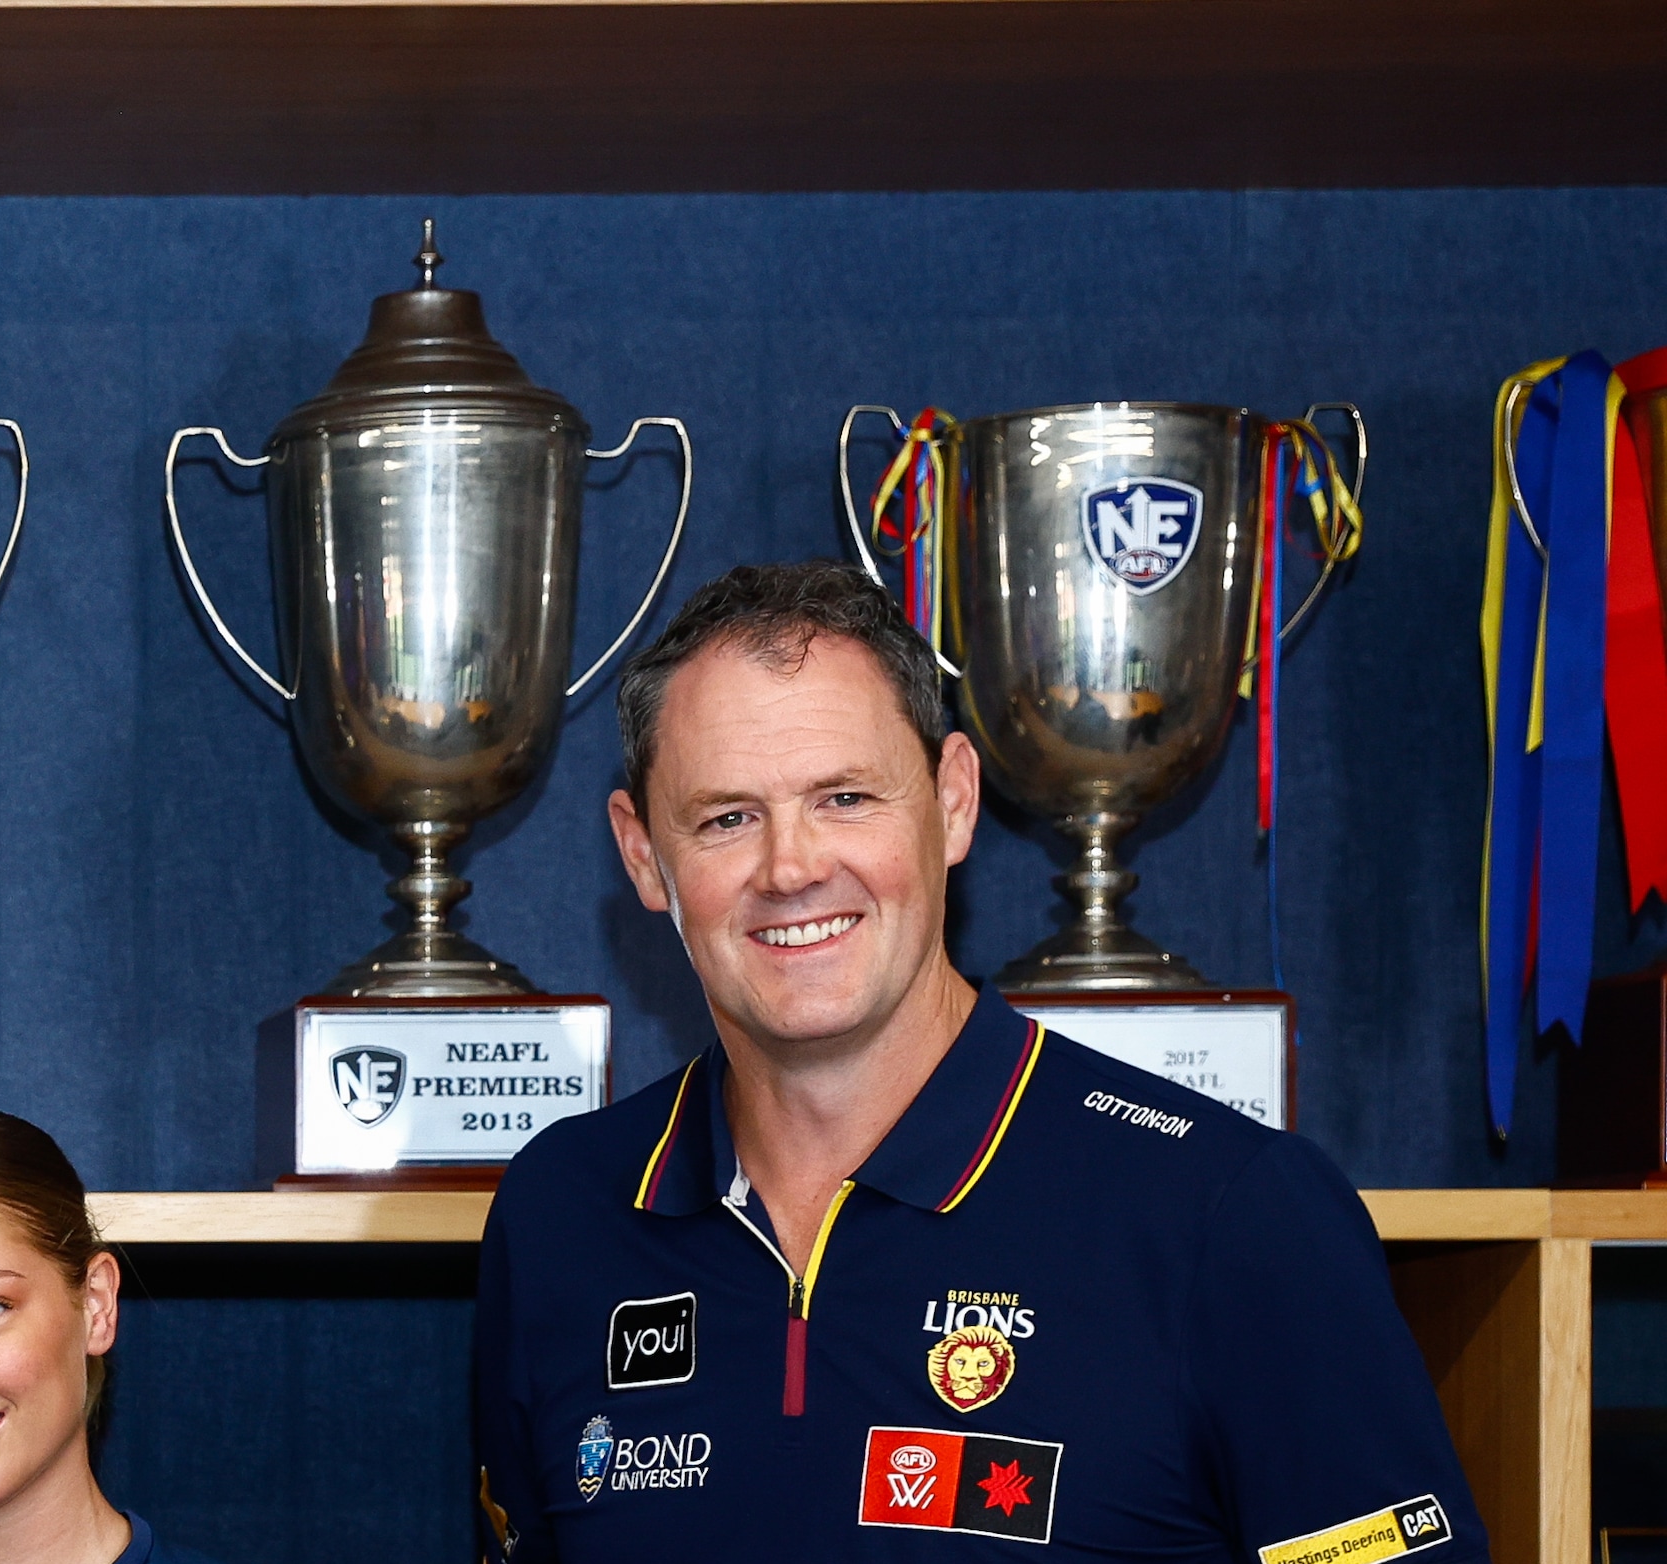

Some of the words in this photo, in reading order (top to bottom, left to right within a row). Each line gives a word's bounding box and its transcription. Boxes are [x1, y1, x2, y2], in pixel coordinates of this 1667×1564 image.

[445, 1042, 549, 1063] NEAFL
[1164, 1050, 1209, 1066] 2017
[412, 1076, 583, 1097] PREMIERS
[462, 1112, 533, 1131] 2013
[947, 1289, 1020, 1306] BRISBANE
[922, 1300, 1035, 1339] LIONS
[623, 1309, 687, 1371] youi
[614, 1432, 712, 1470] BOND
[896, 1452, 929, 1467] AFL
[611, 1466, 709, 1491] UNIVERSITY
[1402, 1505, 1441, 1538] CAT
[1341, 1527, 1396, 1554] Deering
